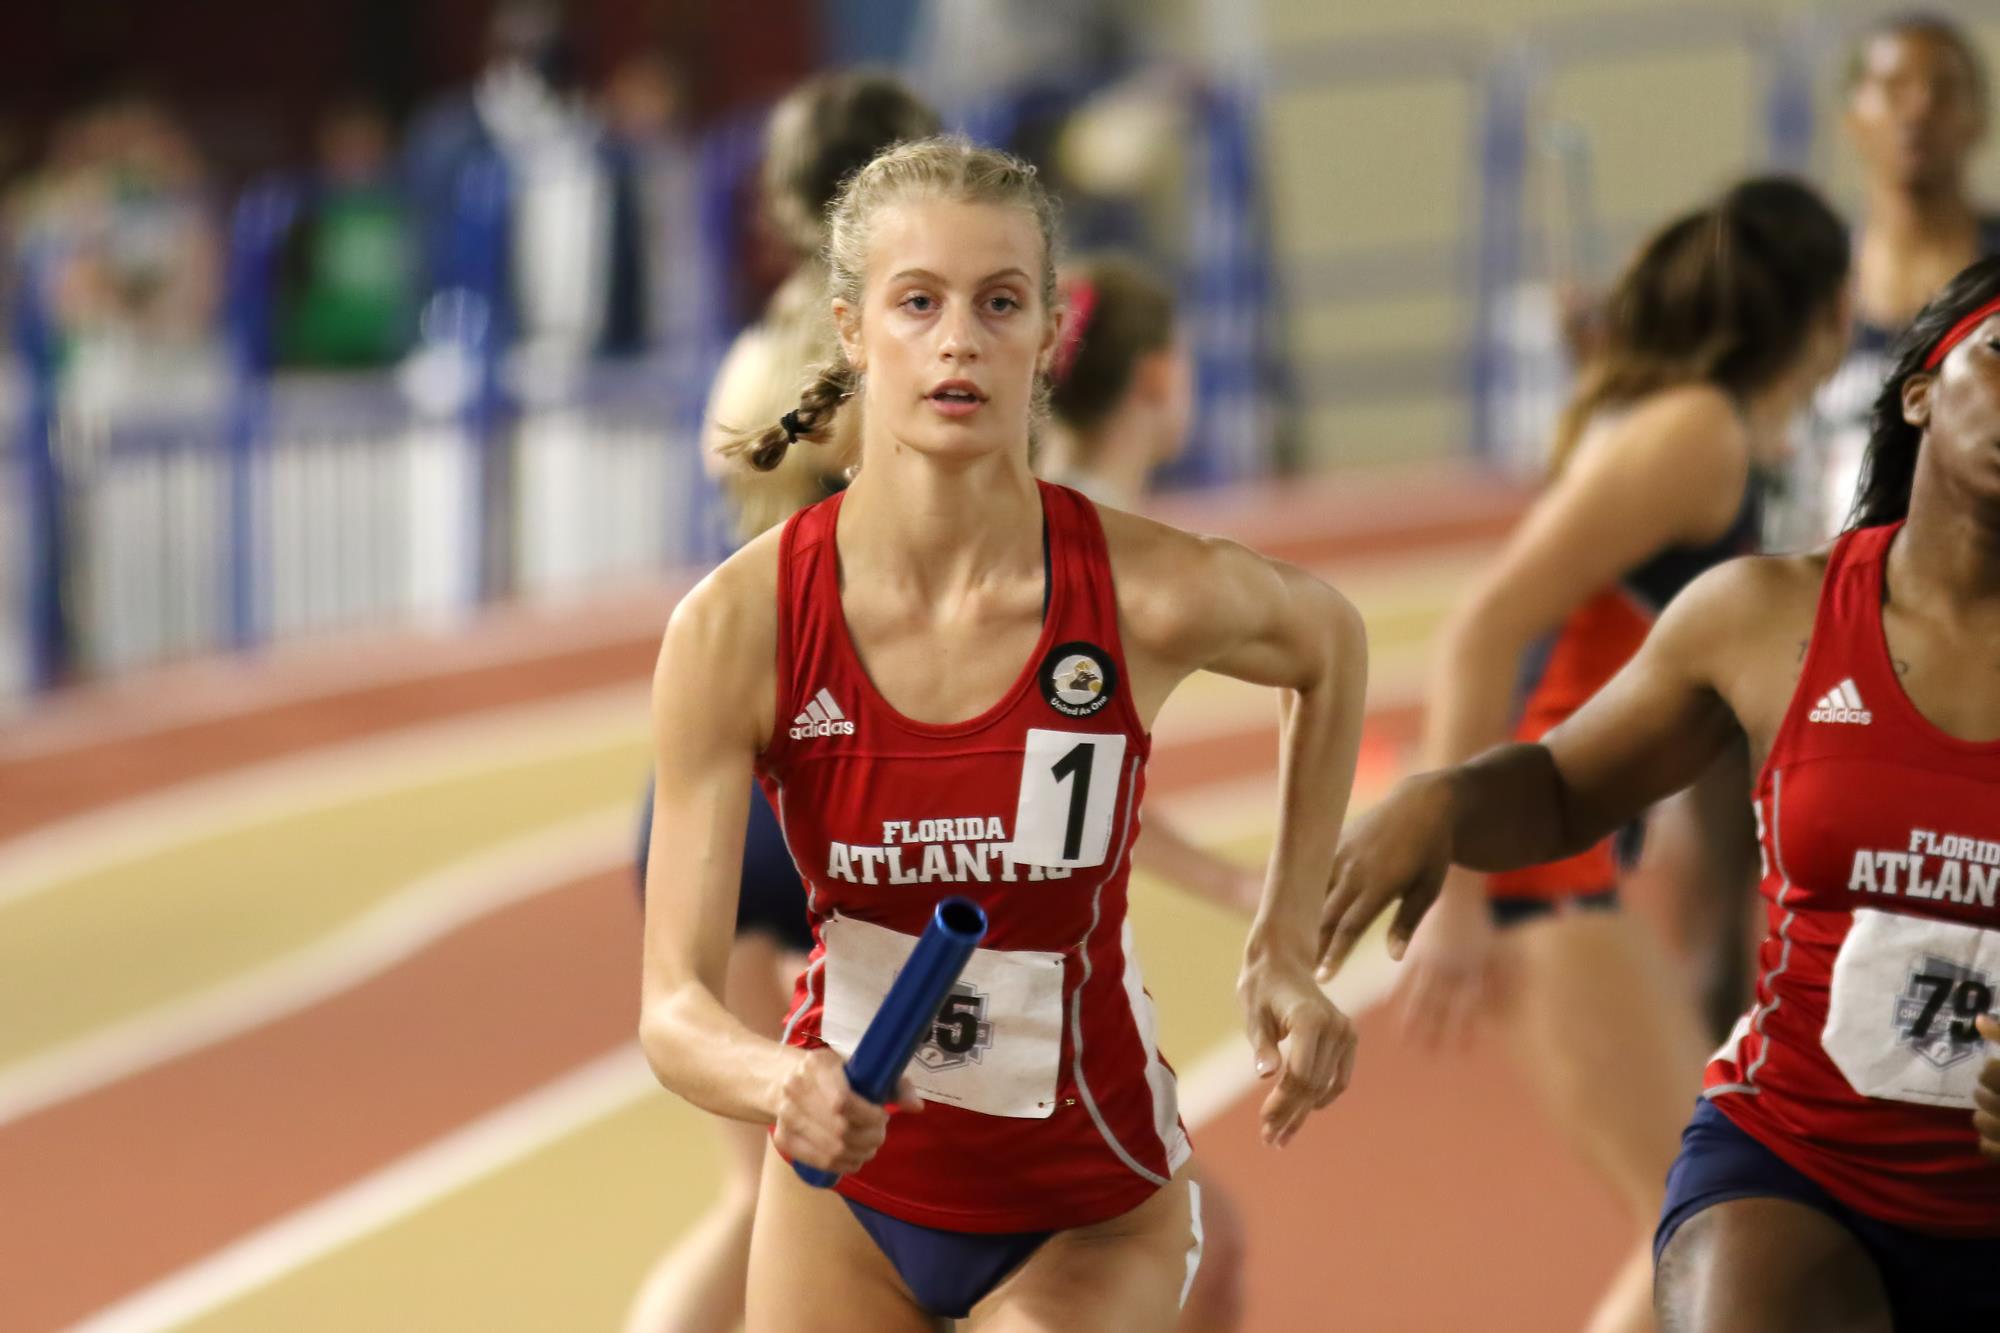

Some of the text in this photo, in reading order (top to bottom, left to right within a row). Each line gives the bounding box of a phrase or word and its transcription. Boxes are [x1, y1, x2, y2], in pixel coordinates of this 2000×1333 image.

[1051, 697, 1078, 715] United
[1809, 709, 1872, 725] adidas
[789, 719, 854, 740] adidas
[1050, 742, 1095, 861] 1
[882, 816, 1006, 845] FLORIDA
[1910, 974, 1991, 1042] 79
